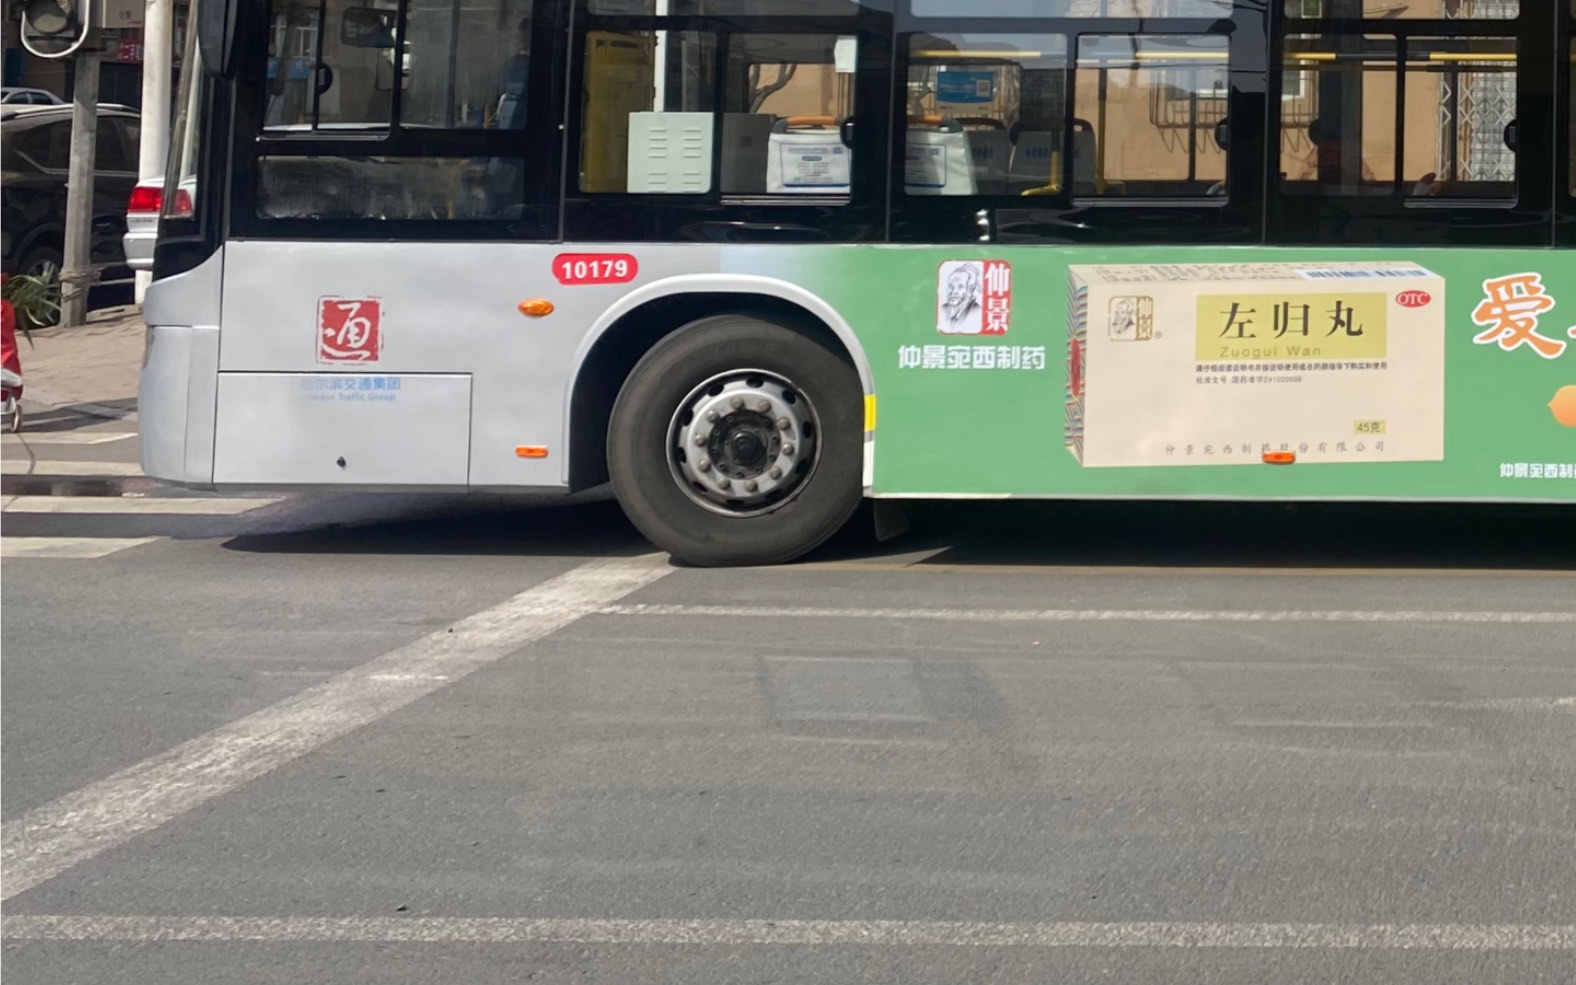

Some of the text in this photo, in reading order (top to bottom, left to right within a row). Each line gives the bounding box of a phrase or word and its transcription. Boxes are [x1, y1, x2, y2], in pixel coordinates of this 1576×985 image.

[561, 260, 628, 279] 10179
[984, 263, 1011, 332] 仲景
[1398, 292, 1429, 305] OTC
[1219, 300, 1364, 339] 左归丸
[898, 344, 1046, 370] 仲景宛西制药
[1220, 345, 1321, 359] Zuogui Wan
[1356, 421, 1381, 433] 45克
